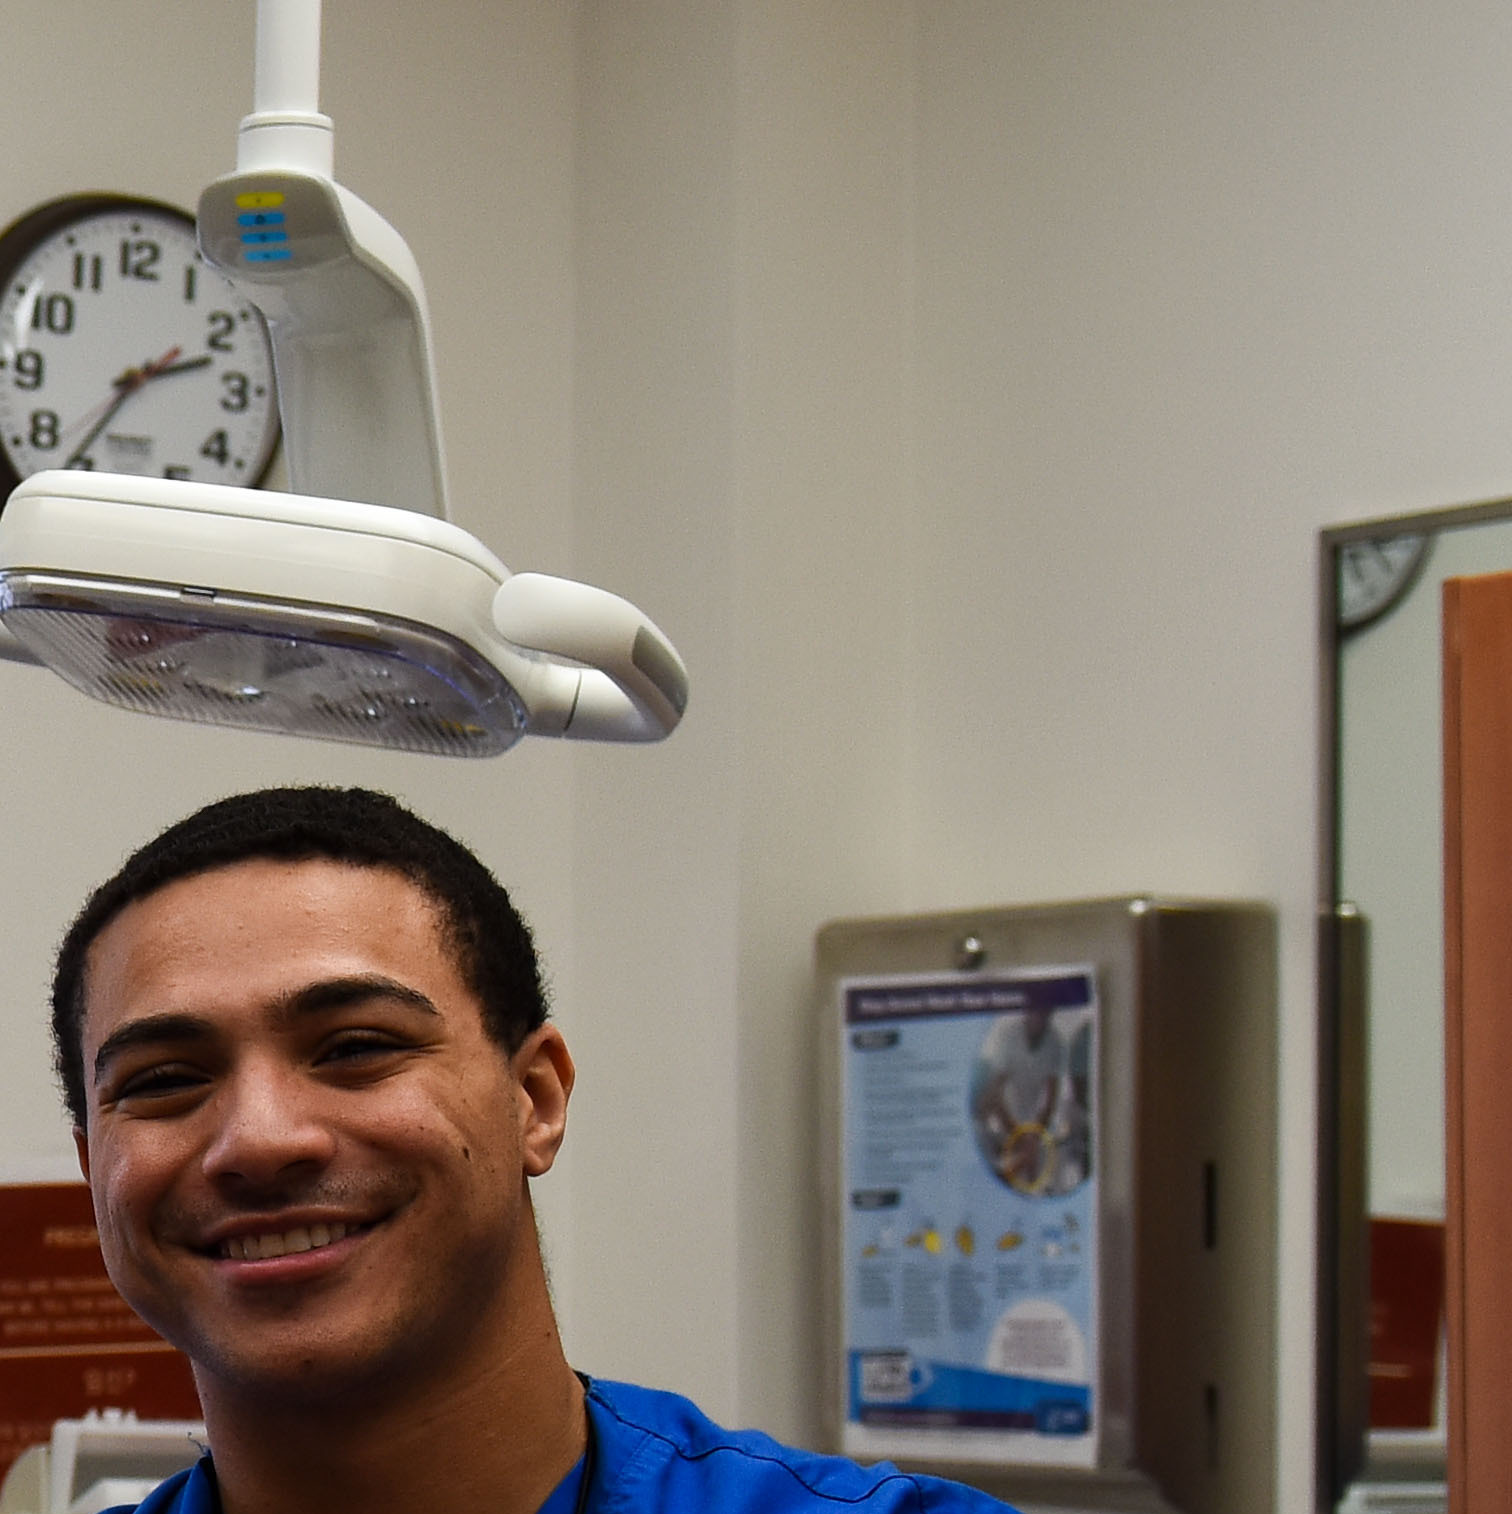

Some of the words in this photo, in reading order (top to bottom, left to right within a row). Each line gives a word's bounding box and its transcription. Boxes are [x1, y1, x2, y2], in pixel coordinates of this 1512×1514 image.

[74, 252, 103, 292] 11
[119, 239, 161, 281] 12
[184, 265, 196, 301] 1
[30, 293, 74, 335] 10
[206, 309, 234, 352] 2
[13, 350, 44, 390] 9
[219, 371, 250, 413] 3
[29, 409, 59, 450] 8
[199, 430, 230, 467] 4
